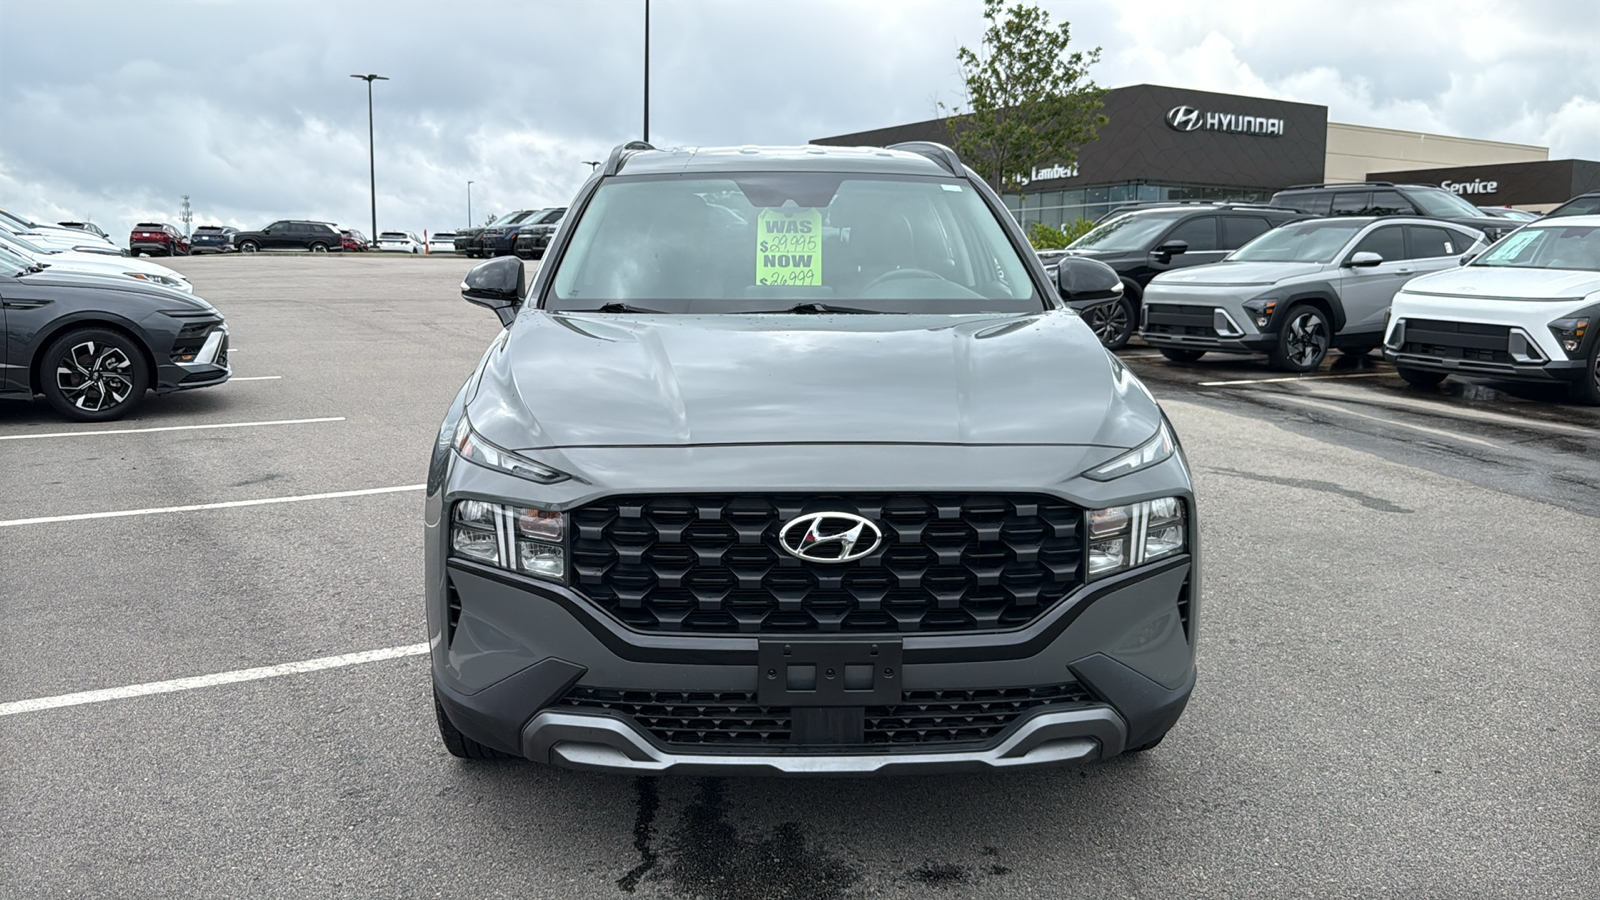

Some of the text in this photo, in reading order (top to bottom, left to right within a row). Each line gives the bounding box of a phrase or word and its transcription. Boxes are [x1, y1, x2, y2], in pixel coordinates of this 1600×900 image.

[1206, 112, 1284, 136] HYUNDAI
[1441, 178, 1498, 195] Service
[765, 220, 812, 234] WAS
[763, 254, 813, 268] NOW
